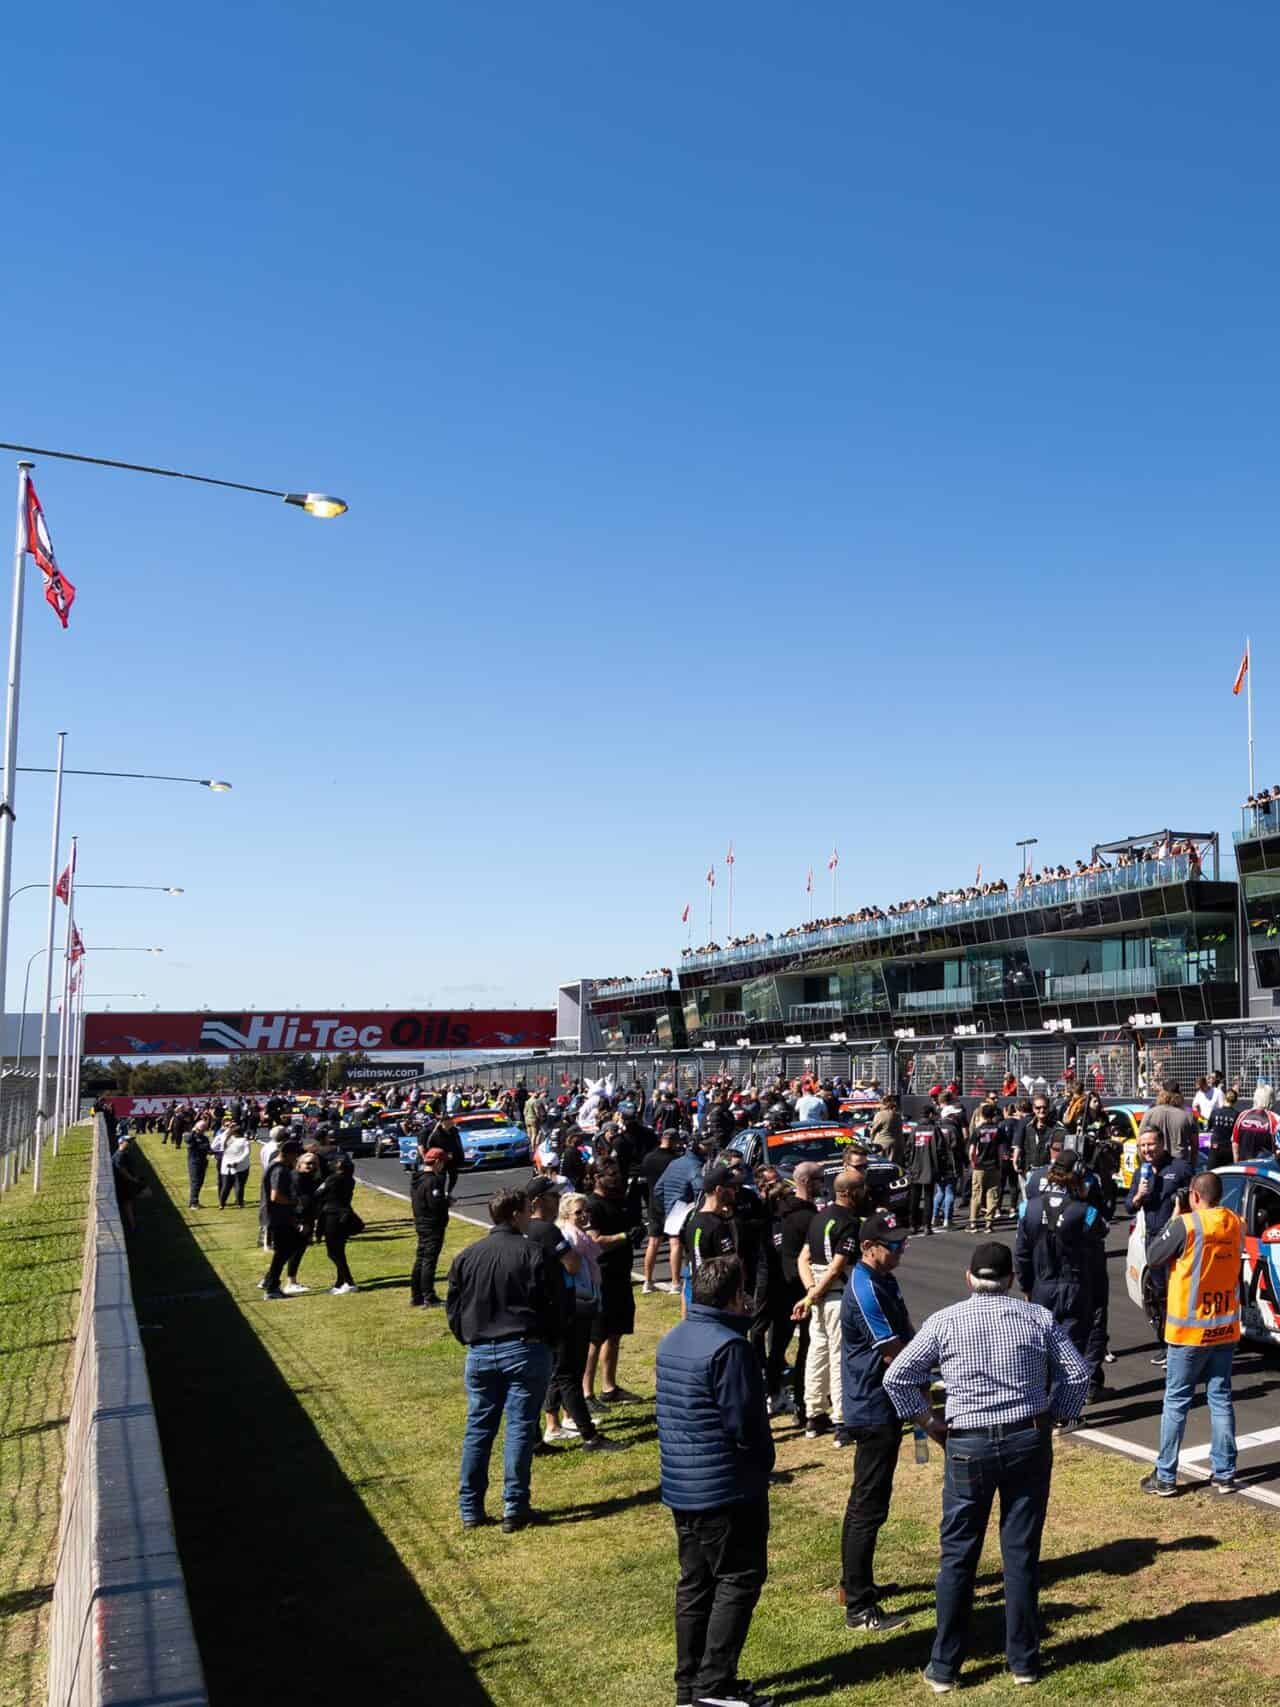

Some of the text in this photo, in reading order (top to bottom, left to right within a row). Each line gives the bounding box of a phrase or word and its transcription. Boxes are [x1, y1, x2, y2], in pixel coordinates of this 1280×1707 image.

[248, 1015, 471, 1049] Hi-Tec Oils
[346, 1066, 418, 1079] visitnsw.com
